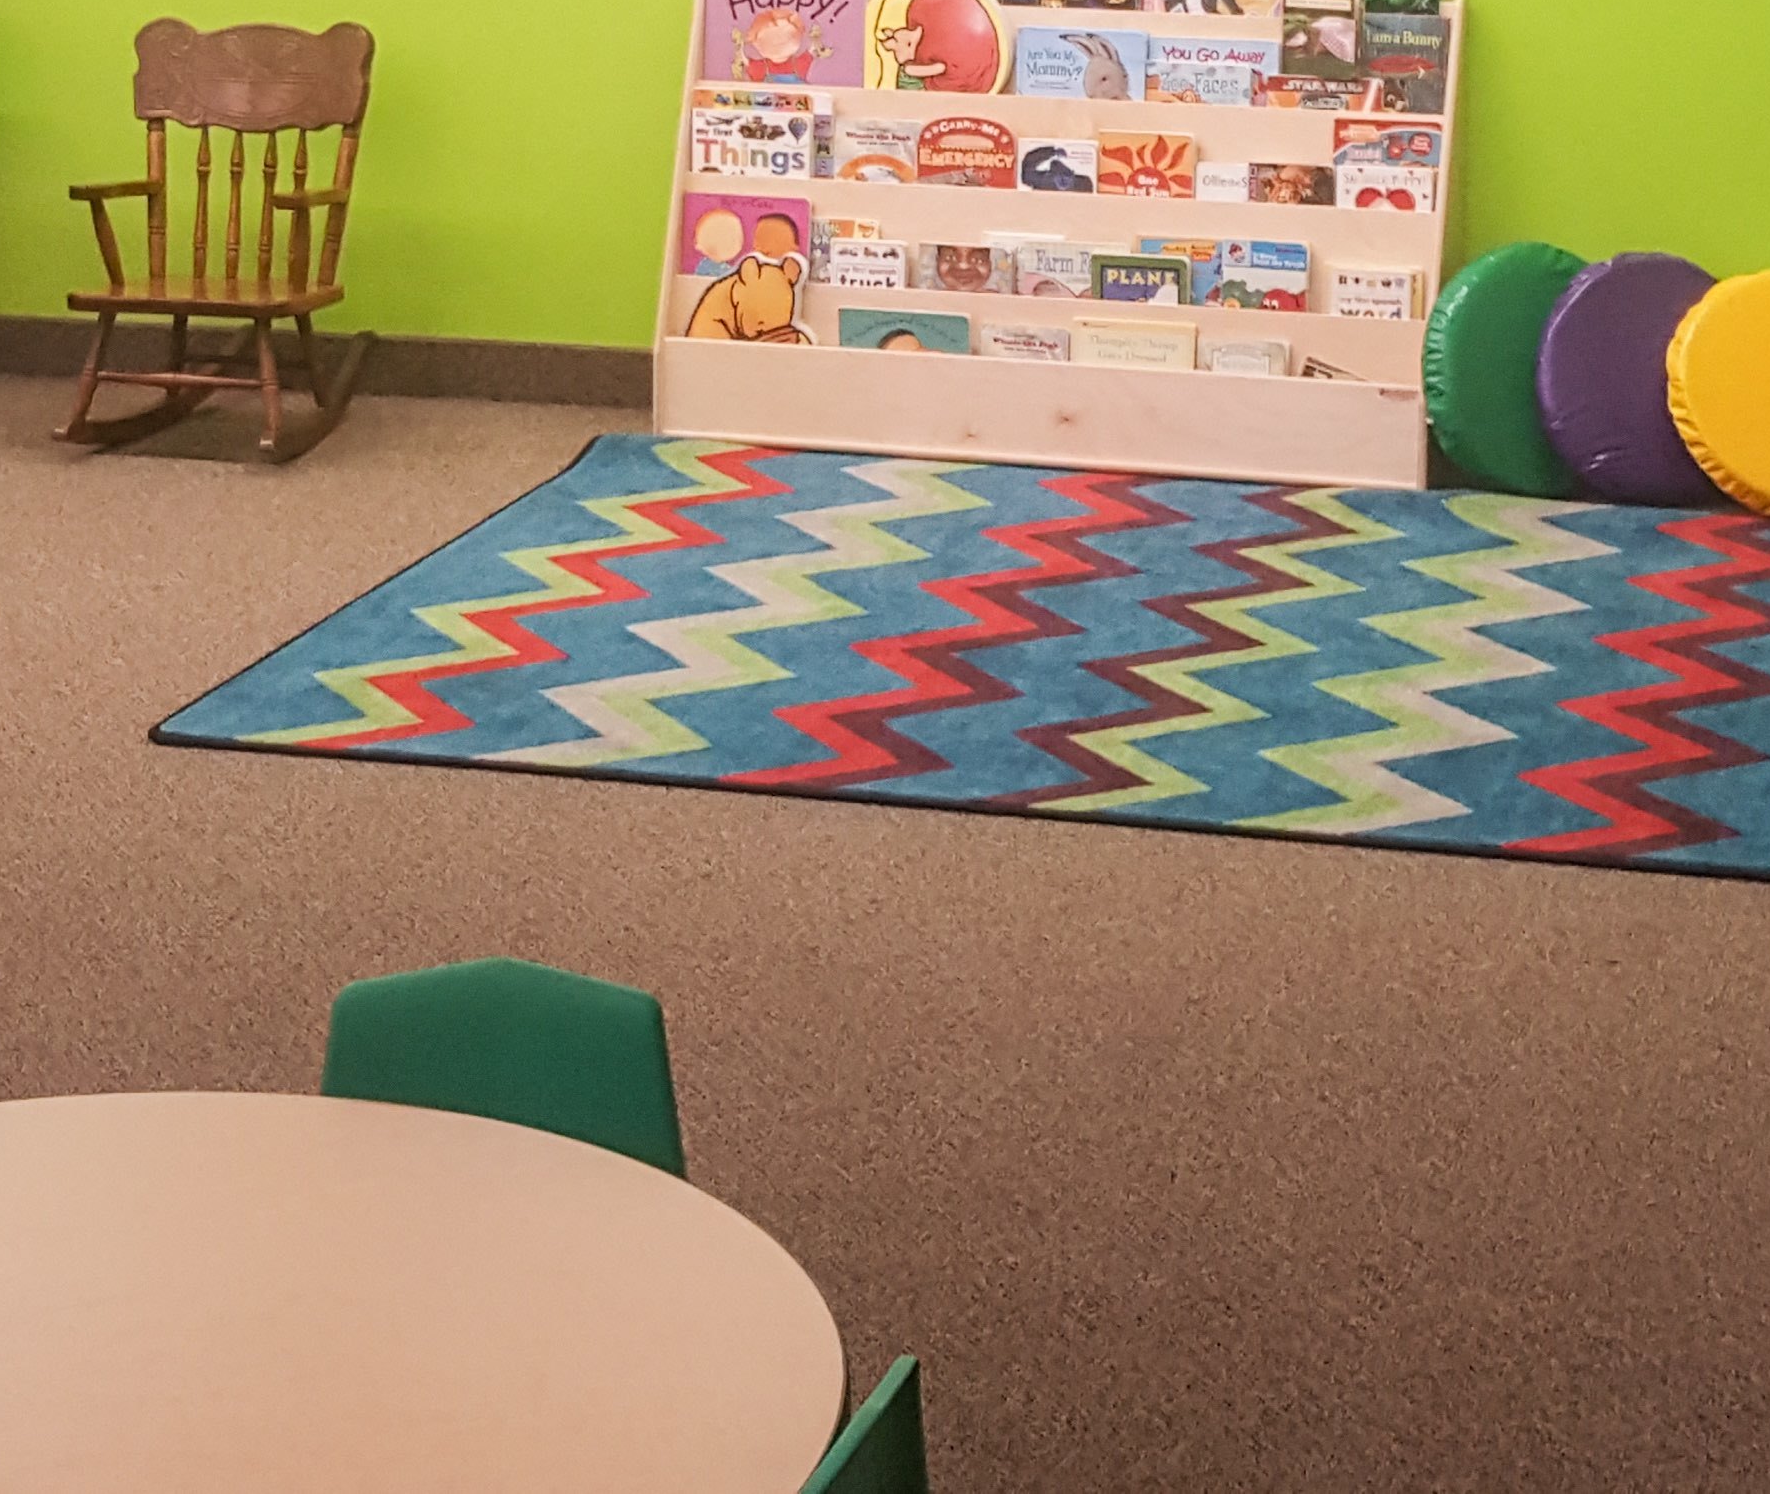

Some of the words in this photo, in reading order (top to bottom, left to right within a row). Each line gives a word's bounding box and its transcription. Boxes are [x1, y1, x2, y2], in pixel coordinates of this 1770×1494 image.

[1402, 31, 1441, 49] Bunny
[1026, 62, 1083, 81] Mommy?
[1194, 73, 1239, 93] Faces
[696, 137, 805, 175] Things
